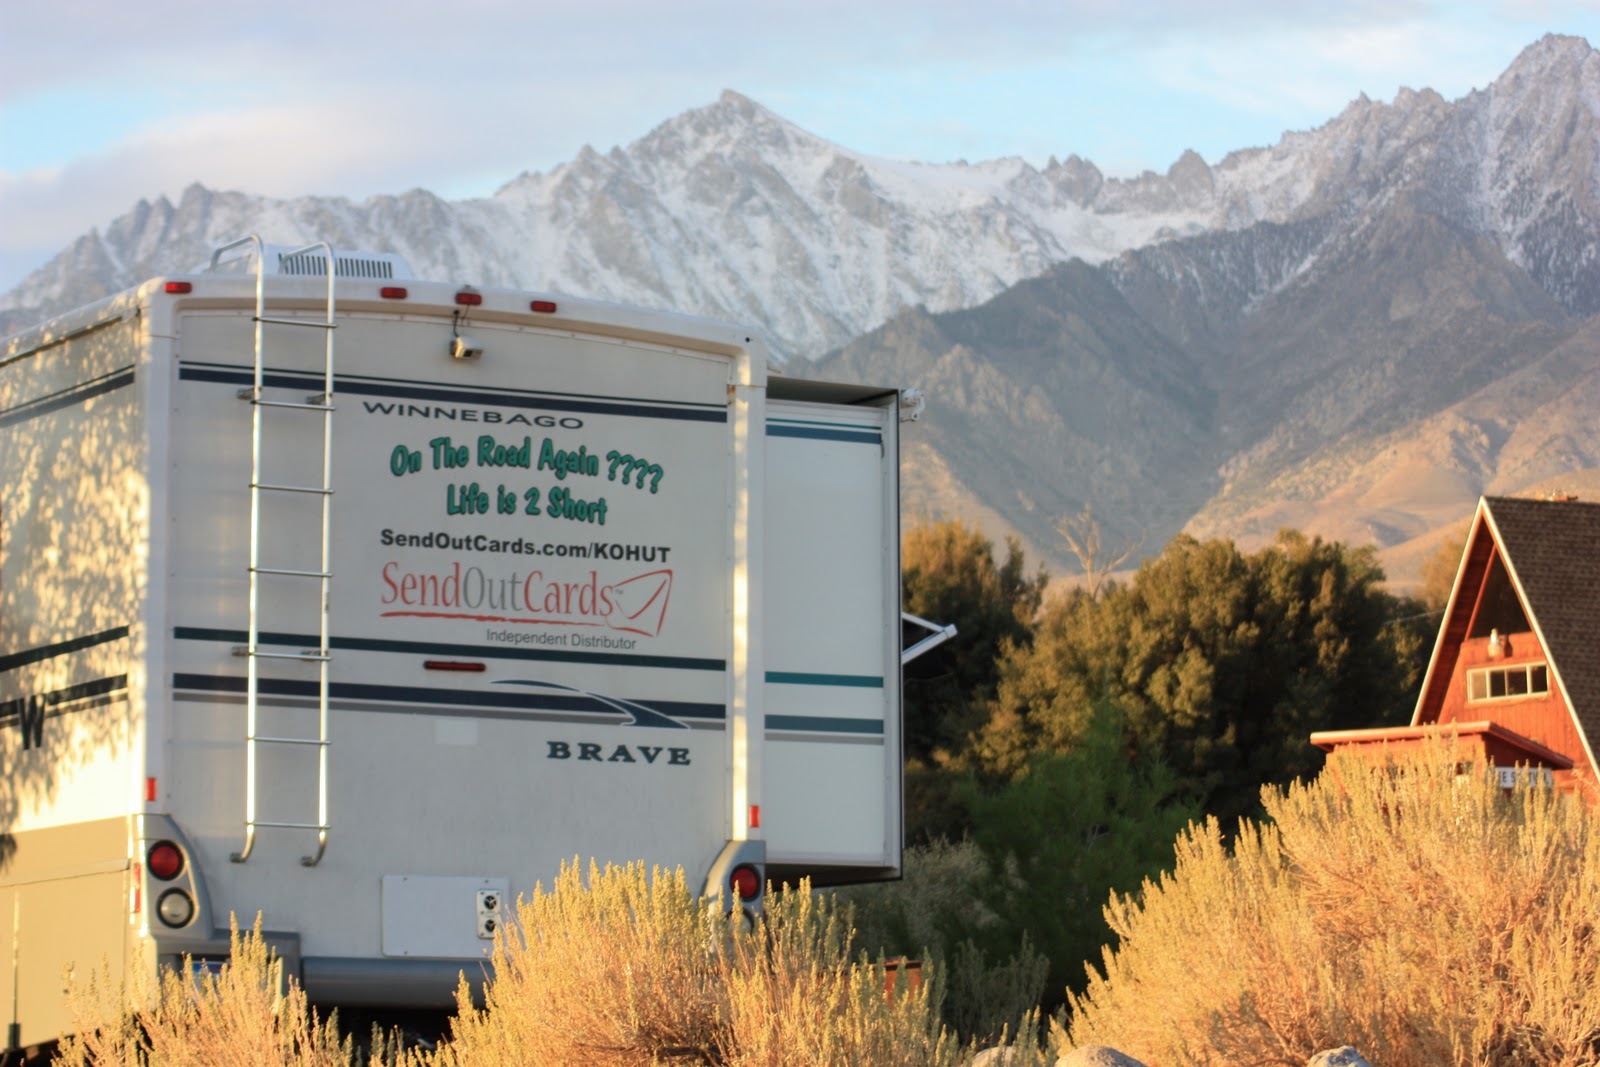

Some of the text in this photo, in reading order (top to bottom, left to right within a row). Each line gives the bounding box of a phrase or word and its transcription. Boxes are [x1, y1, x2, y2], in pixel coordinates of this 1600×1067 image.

[362, 401, 584, 429] WINNEBAGO
[390, 435, 664, 494] On The Road Again ????
[447, 482, 489, 516] Life
[524, 486, 541, 516] 2
[547, 486, 607, 526] Short
[380, 528, 671, 563] SendOutCards.com/KOHUT
[380, 561, 614, 617] SendOutCards
[486, 629, 637, 651] Independent Distributor
[547, 741, 691, 766] BRAVE
